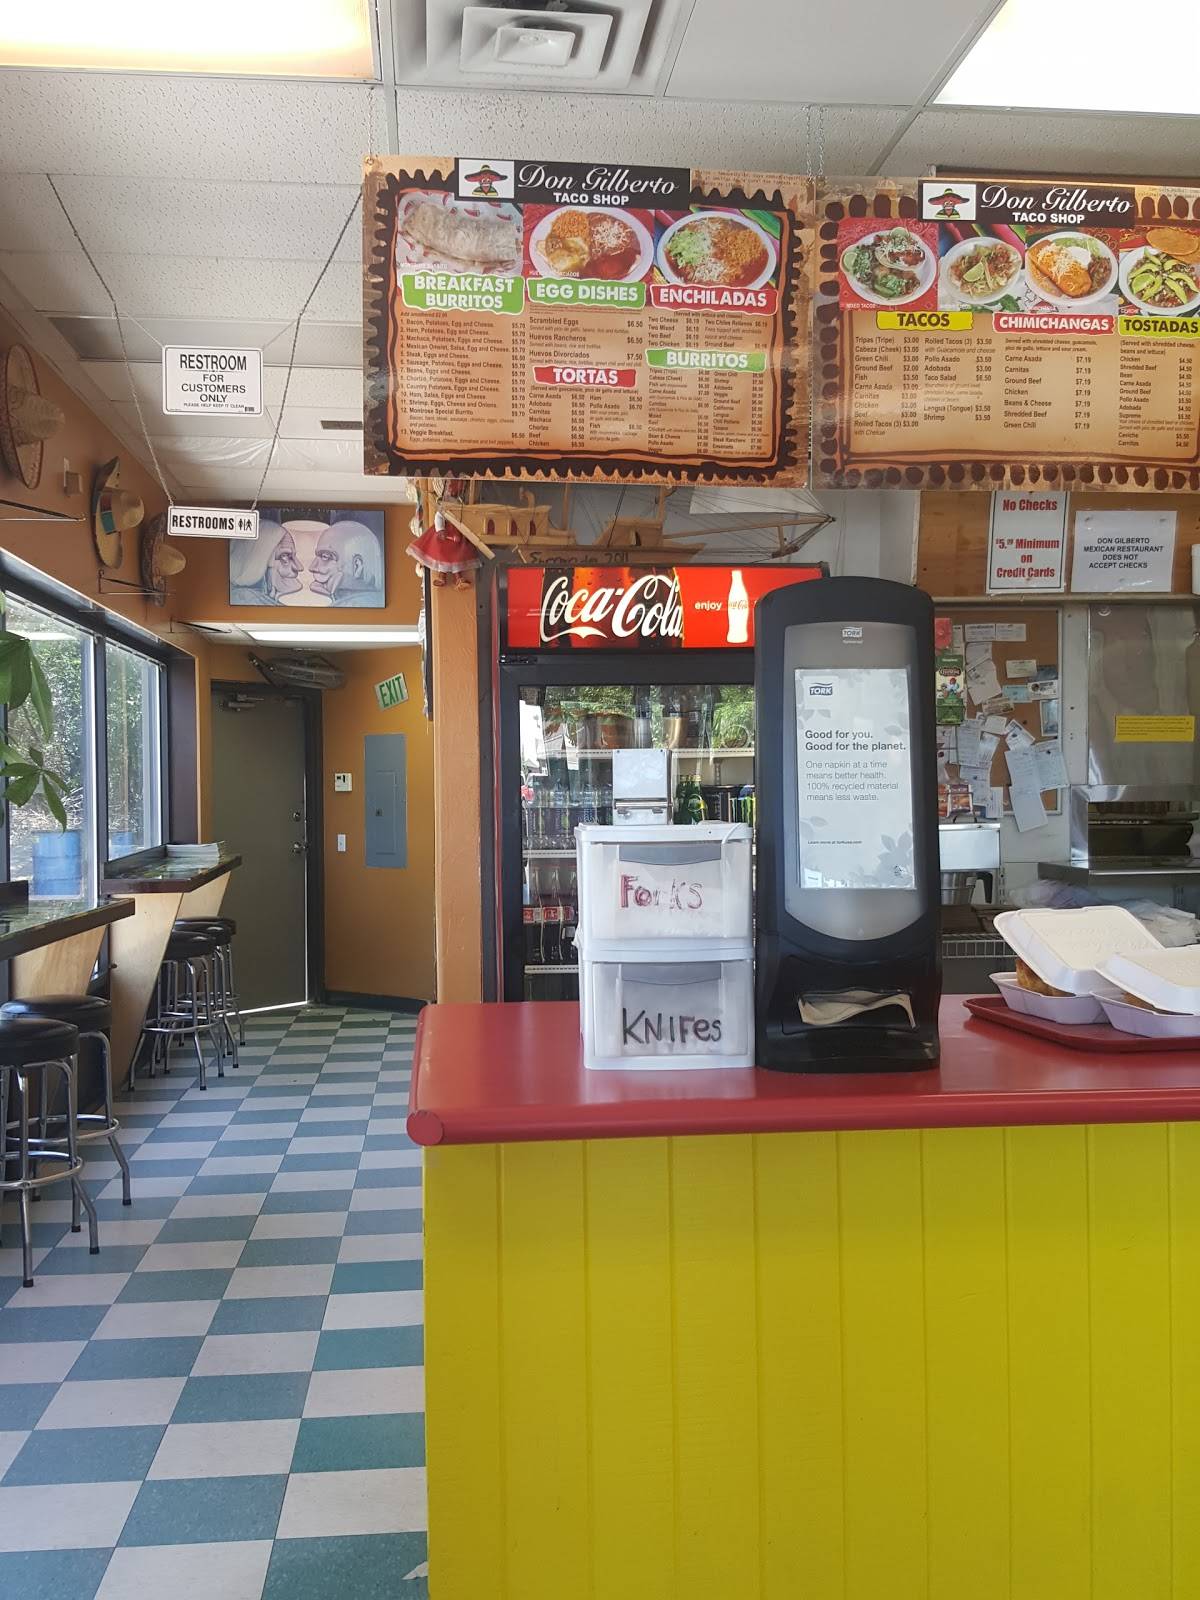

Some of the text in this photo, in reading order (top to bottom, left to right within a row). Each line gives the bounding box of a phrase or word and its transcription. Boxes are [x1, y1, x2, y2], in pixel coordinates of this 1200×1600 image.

[518, 163, 680, 195] Don Gilberto
[553, 191, 630, 206] TACO SHOP
[980, 184, 1134, 214] Don Gilberto
[1012, 211, 1086, 224] TACO SHOP
[414, 274, 514, 294] BREAKFAST
[536, 283, 638, 302] EGG DISHES
[659, 287, 768, 308] ENCHILADAS
[425, 293, 503, 309] BURRITOS
[529, 316, 643, 328] Scrambled Eggs $6.50
[896, 313, 950, 328] TACOS
[999, 315, 1109, 331] CHIMICHANGAS
[1123, 318, 1199, 334] TOSTADAS
[529, 333, 643, 345] Huevos Rancheros $6.50
[855, 336, 920, 344] Tripas (Tripe) $3.00
[553, 350, 590, 358] Divorciados
[627, 353, 643, 361] $7.50
[666, 352, 748, 369] BURRITOS
[180, 353, 247, 371] RESTROOM
[202, 374, 224, 383] FOR
[553, 367, 618, 385] TORTAS
[854, 373, 868, 381] Fish
[924, 373, 939, 381] Taco
[1028, 377, 1042, 385] Beef
[1075, 378, 1091, 386] $7.19
[181, 383, 247, 394] CUSTOMERS
[1004, 388, 1091, 397] Chicken $7.19
[199, 393, 228, 403] ONLY
[1075, 400, 1091, 408] $7.19
[923, 413, 991, 422] Shrimp $3.50
[1074, 411, 1091, 419] $7.19
[1003, 421, 1090, 430] Green Chili $7.19
[1003, 498, 1058, 511] No Checks
[172, 514, 234, 531] RESTROOMS
[1015, 538, 1060, 550] Minimum
[1097, 537, 1151, 545] DON GILBERTO
[1083, 545, 1164, 553] MEXICAN RESTAURANT
[1020, 554, 1033, 563] on
[996, 567, 1055, 578] Credit Cards
[539, 574, 723, 643] Coca-Cola enjoy
[842, 629, 863, 638] TORK
[378, 675, 404, 708] EXIT
[809, 686, 833, 696] TORK
[805, 729, 873, 740] Good for you.
[805, 741, 906, 752] Good for the planet.
[805, 760, 823, 769] One
[824, 761, 851, 770] napkin
[852, 761, 861, 769] at
[870, 760, 888, 769] time
[834, 771, 858, 779] better
[860, 771, 887, 779] health.
[807, 782, 899, 792] 100% recycled material
[835, 793, 851, 801] less
